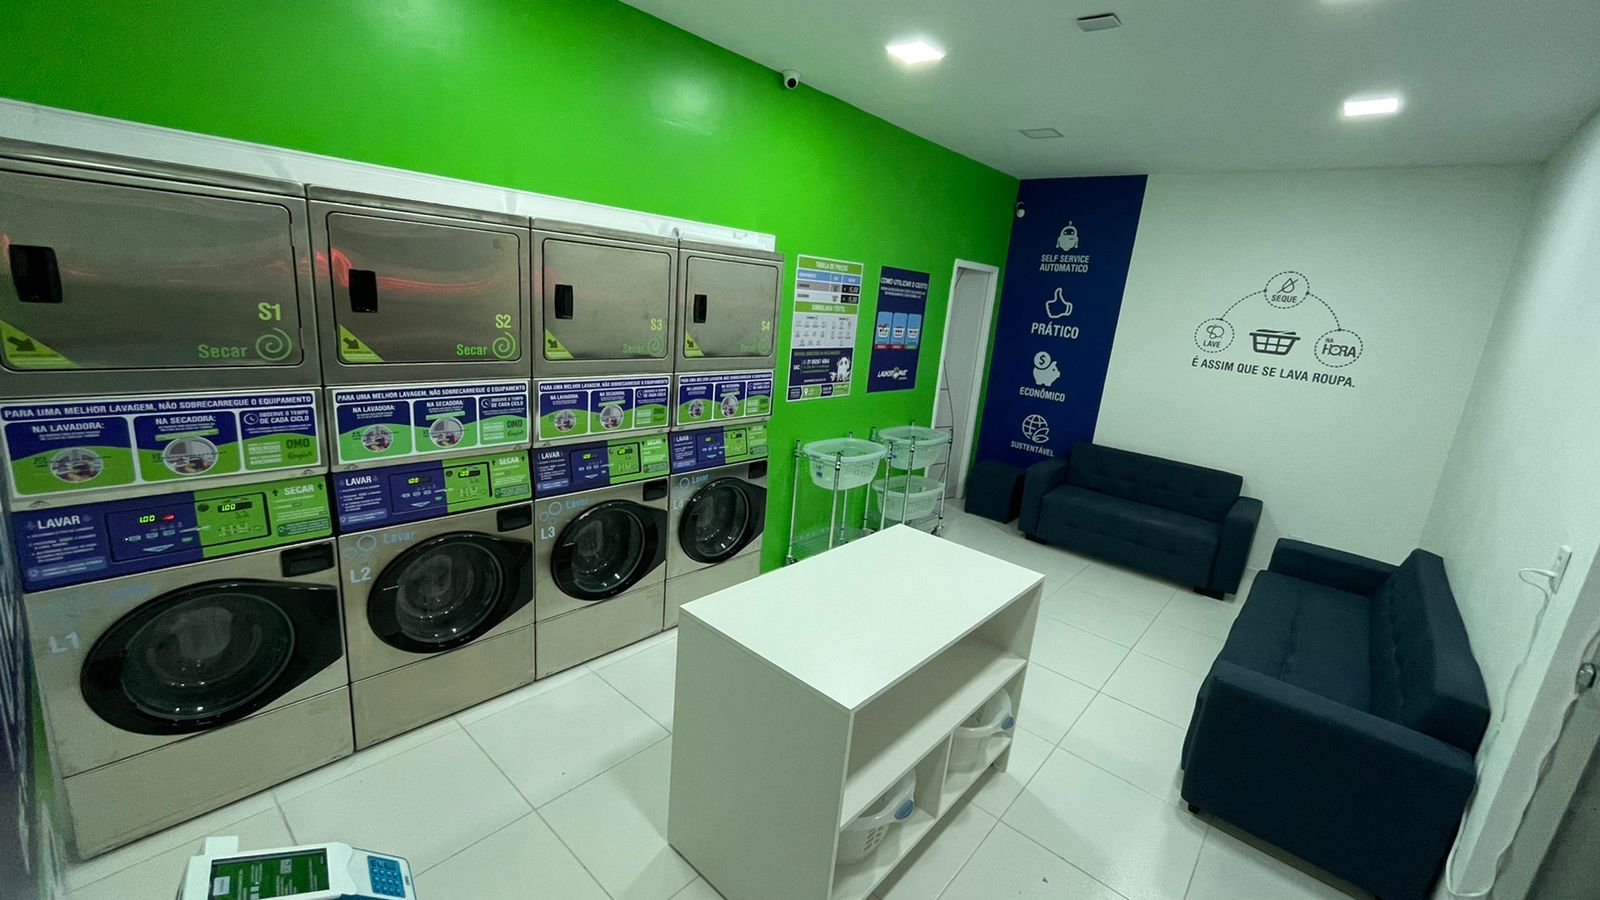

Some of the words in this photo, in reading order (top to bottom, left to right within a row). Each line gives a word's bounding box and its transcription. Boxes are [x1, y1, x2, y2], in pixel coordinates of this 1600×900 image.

[1040, 254, 1059, 262] SELF
[1060, 255, 1090, 264] SERVICE
[1040, 263, 1089, 273] AUTOMATICO
[880, 277, 893, 285] COMO
[1270, 294, 1298, 304] SEQUE
[257, 302, 282, 321] S1
[495, 314, 512, 329] S2
[650, 318, 662, 331] S3
[1030, 321, 1080, 339] PRÁTICO
[456, 344, 488, 356] Secar
[1203, 340, 1222, 349] LAVE
[1321, 343, 1357, 358] HORA
[197, 344, 248, 359] Secar
[1191, 355, 1200, 367] É
[1200, 358, 1235, 372] ASSIM
[1236, 362, 1260, 376] QUE
[1261, 366, 1278, 378] SE
[1279, 368, 1309, 382] LAVA
[1312, 372, 1356, 388] ROUPA.
[337, 394, 355, 402] PARA
[356, 393, 371, 401] UMA
[372, 392, 398, 400] MELHOR
[1019, 386, 1066, 402] ECONÔMICO
[4, 409, 35, 418] PARA
[36, 408, 62, 417] UMA
[64, 405, 107, 415] MELHOR
[158, 401, 177, 410] NÃO
[179, 399, 249, 409] SOBRECARREGUE
[258, 396, 311, 405] EQUIPAMENTO
[270, 416, 289, 424] CADA
[32, 425, 48, 434] NA
[286, 438, 310, 449] OMO
[1010, 440, 1055, 457] SUSTENTÁVEL
[498, 456, 520, 466] SECAR
[541, 451, 560, 460] LAVAR
[344, 475, 372, 487] LAVAR
[284, 484, 314, 496] SECAR
[37, 515, 81, 530] LAVAR
[540, 526, 556, 540] L3
[350, 567, 372, 584] L2
[48, 632, 80, 654] L1
